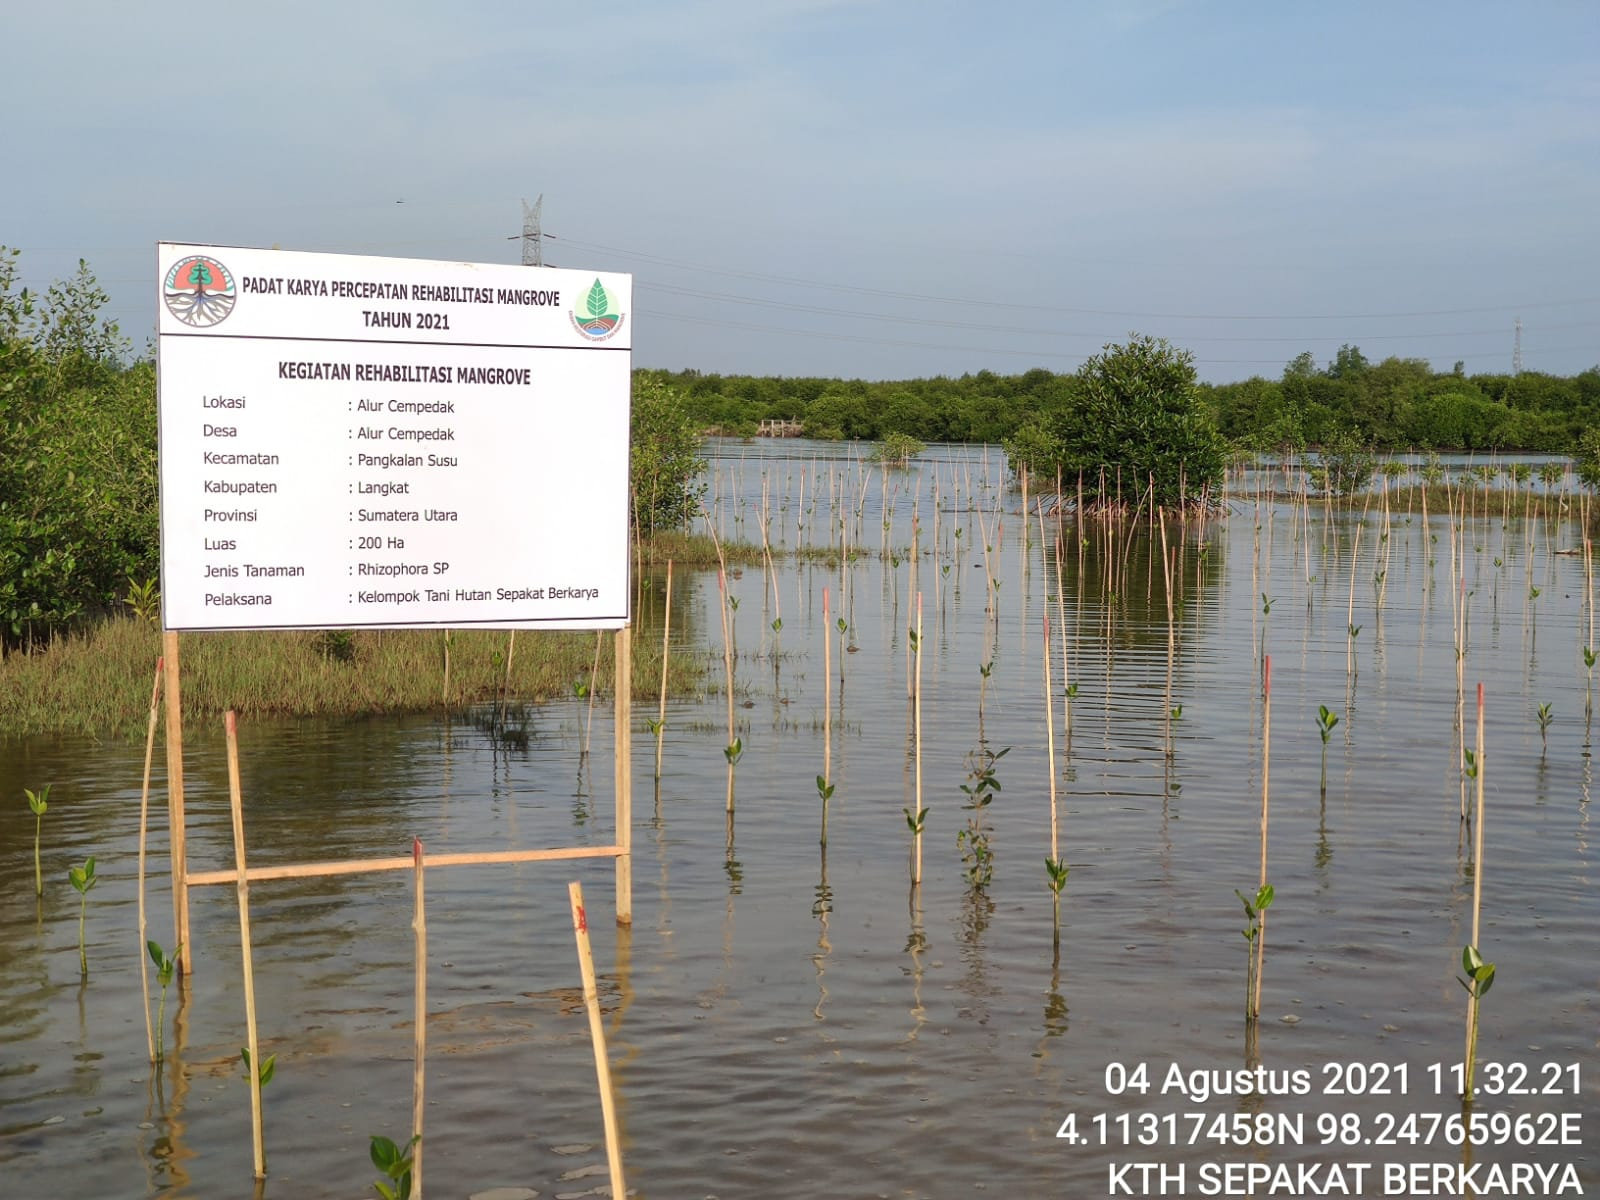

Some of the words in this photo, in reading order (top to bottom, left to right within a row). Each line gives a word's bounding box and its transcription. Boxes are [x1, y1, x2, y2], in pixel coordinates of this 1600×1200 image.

[242, 276, 284, 295] PADAT
[286, 278, 329, 297] KARYA
[331, 280, 408, 301] PERCEPATAN
[411, 284, 494, 304] REHABILITASI
[497, 288, 560, 307] MANGROVE
[361, 310, 412, 329] TAHUN
[416, 312, 450, 331] 2021
[278, 361, 351, 381] KEGIATAN
[355, 363, 453, 384] REHABILITASI
[457, 366, 531, 386] MANGROVE
[203, 395, 246, 409] Lokasi
[357, 398, 385, 412] Alur
[387, 399, 455, 416] Cempedak
[203, 423, 237, 438] Desa
[357, 426, 384, 440] Alur
[387, 426, 455, 443] Cempedak
[203, 451, 279, 465] Kecamatan
[358, 453, 424, 470] Pangkalan
[427, 454, 458, 467] Susu
[204, 479, 278, 496] Kabupaten
[358, 481, 410, 497] Langkat
[204, 508, 257, 522] Provinsi
[358, 508, 419, 522] Sumatera
[424, 509, 458, 522] Utara
[204, 537, 237, 551] Luas
[358, 536, 383, 550] 200
[387, 536, 405, 549] Ha
[204, 564, 239, 578] Jenis
[242, 564, 305, 578] Tanaman
[358, 562, 429, 578] Rhizophora
[433, 561, 450, 575] SP
[205, 592, 272, 607] Pelaksana
[358, 589, 421, 606] Kelompok
[424, 589, 450, 602] Tani
[455, 589, 492, 601] Hutan
[496, 587, 545, 603] Sepakat
[548, 586, 599, 601] Berkarya
